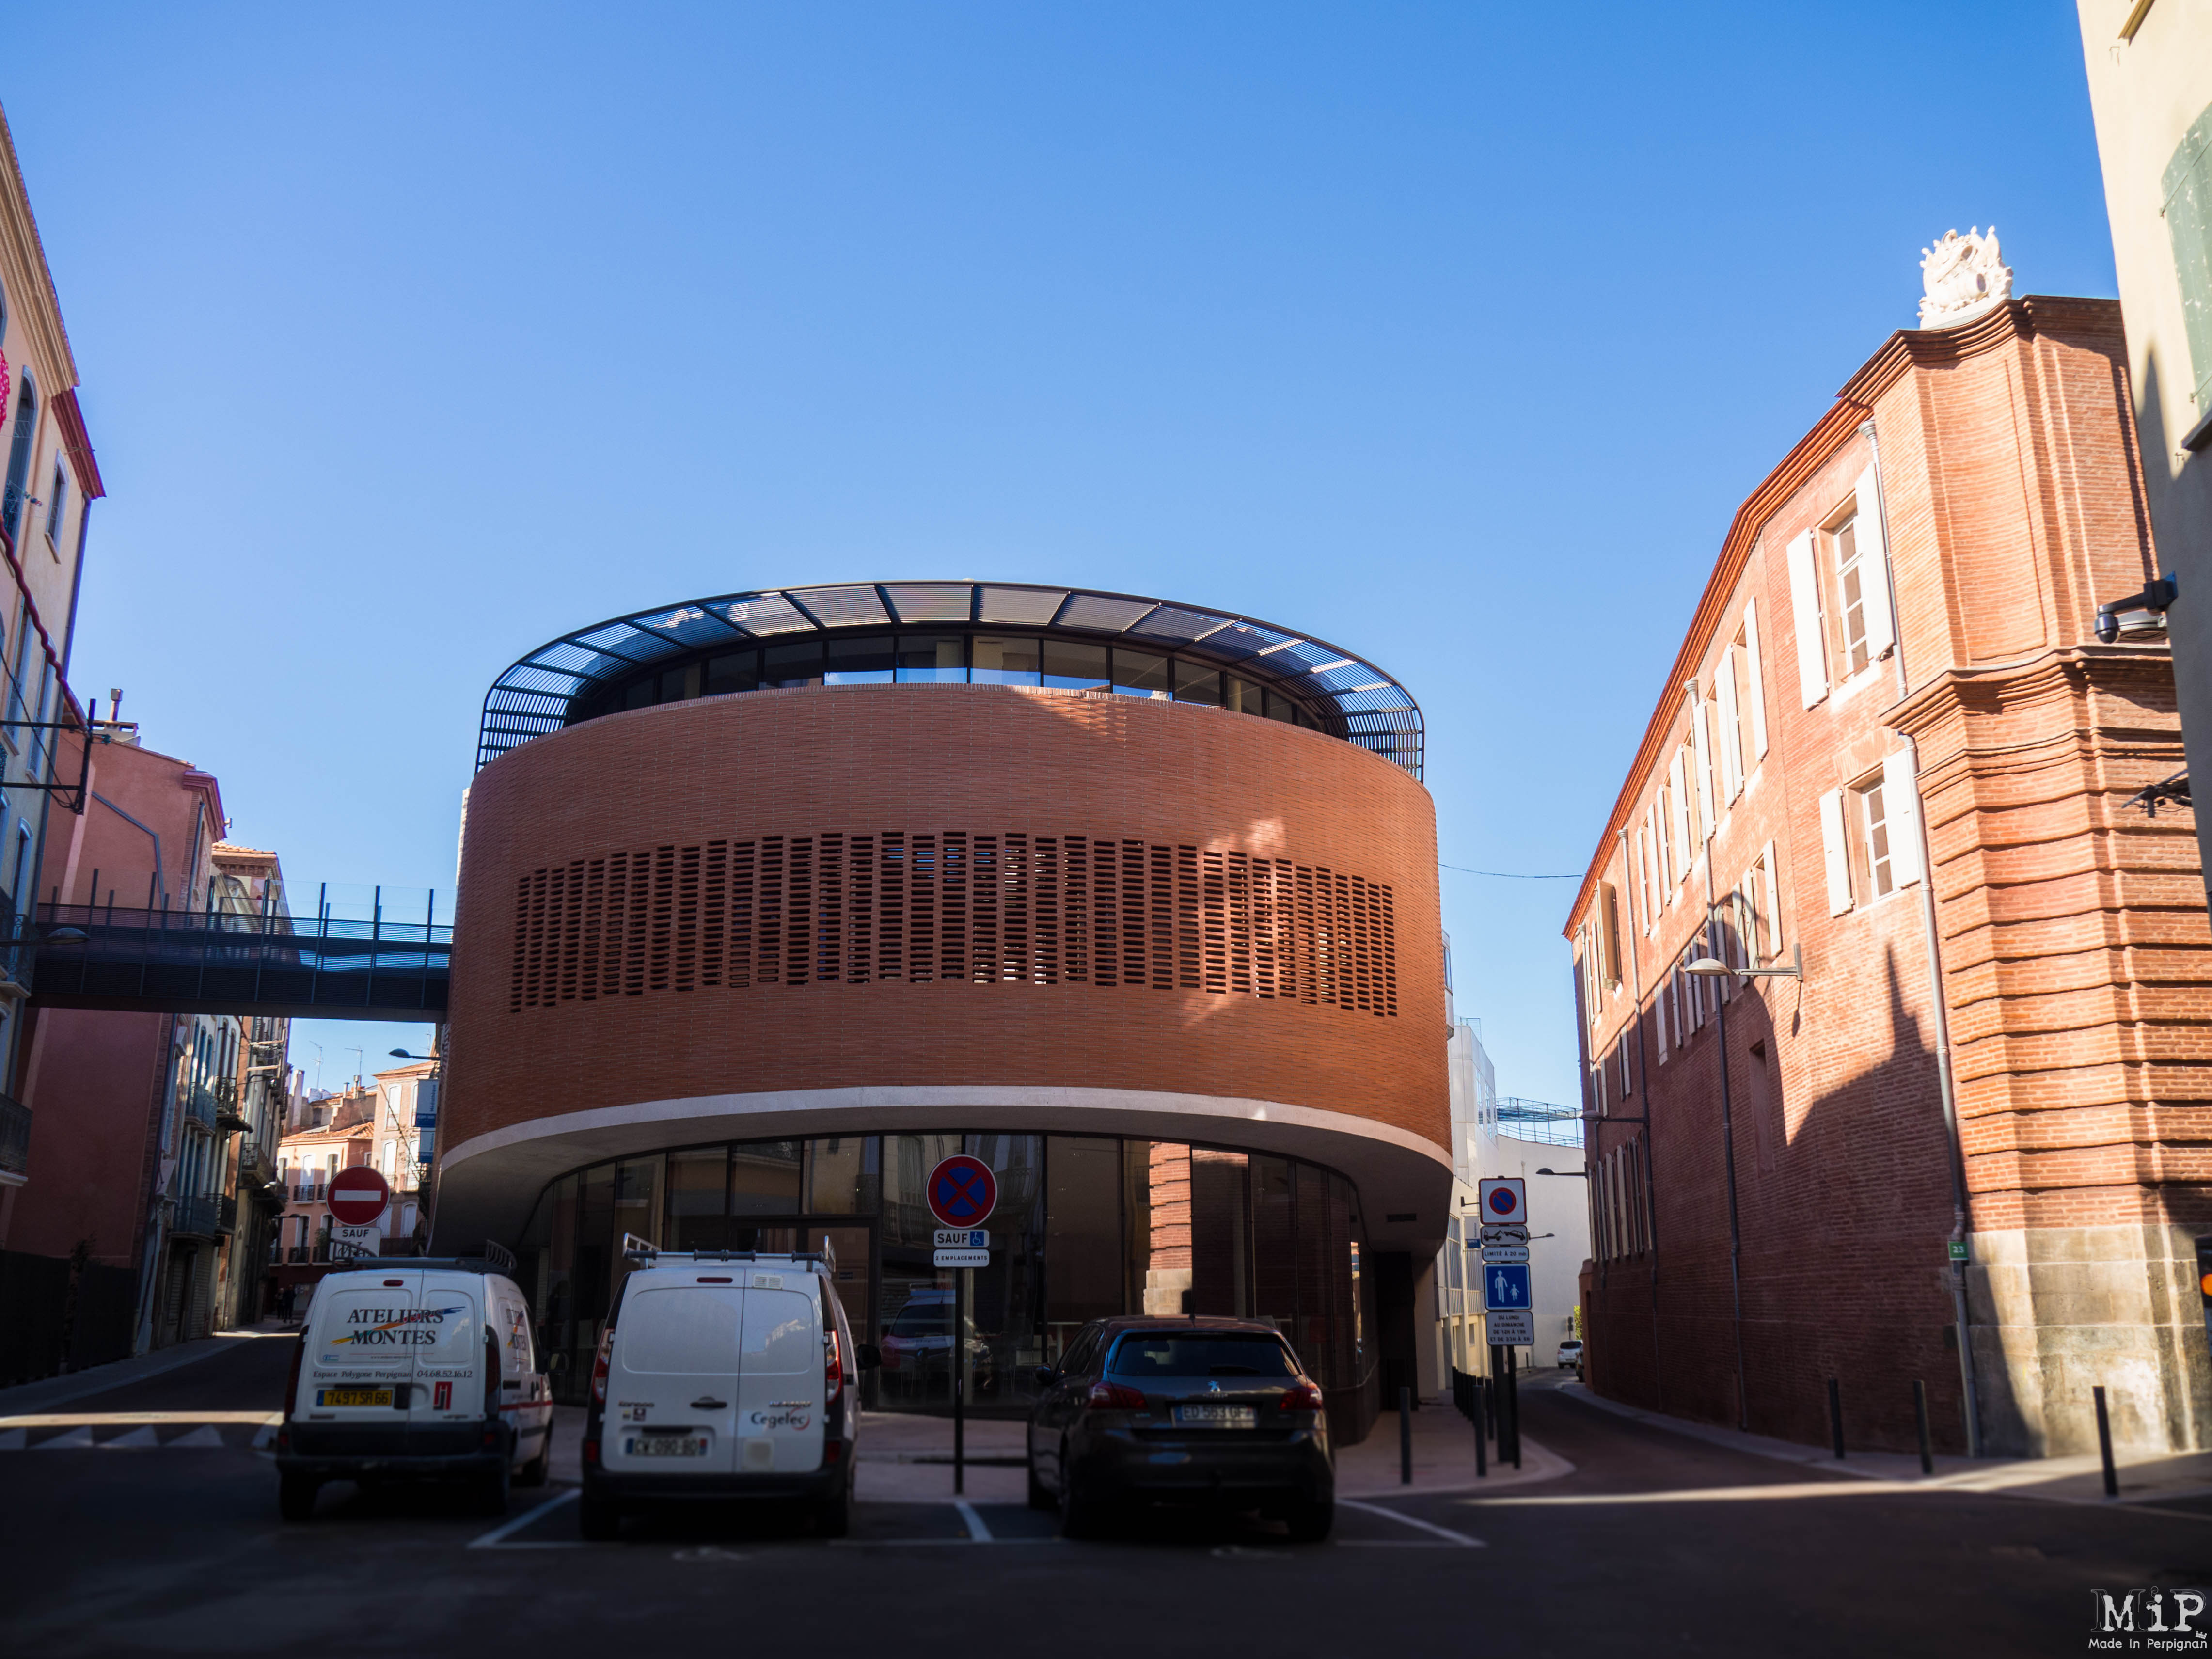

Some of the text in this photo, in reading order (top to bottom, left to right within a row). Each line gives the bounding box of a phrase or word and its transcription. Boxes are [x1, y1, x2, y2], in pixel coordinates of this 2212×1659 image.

[342, 1229, 369, 1237] SAUF
[938, 1233, 968, 1243] SAUF
[1953, 1245, 1964, 1253] 23
[347, 1309, 444, 1323] ATELIERS
[350, 1330, 436, 1344] MONTES
[314, 1370, 473, 1379] Espace Polygone Perpignan 04.68.52.16.12
[328, 1392, 357, 1404] 7497
[375, 1392, 389, 1404] 66
[751, 1411, 806, 1429] Cegelec
